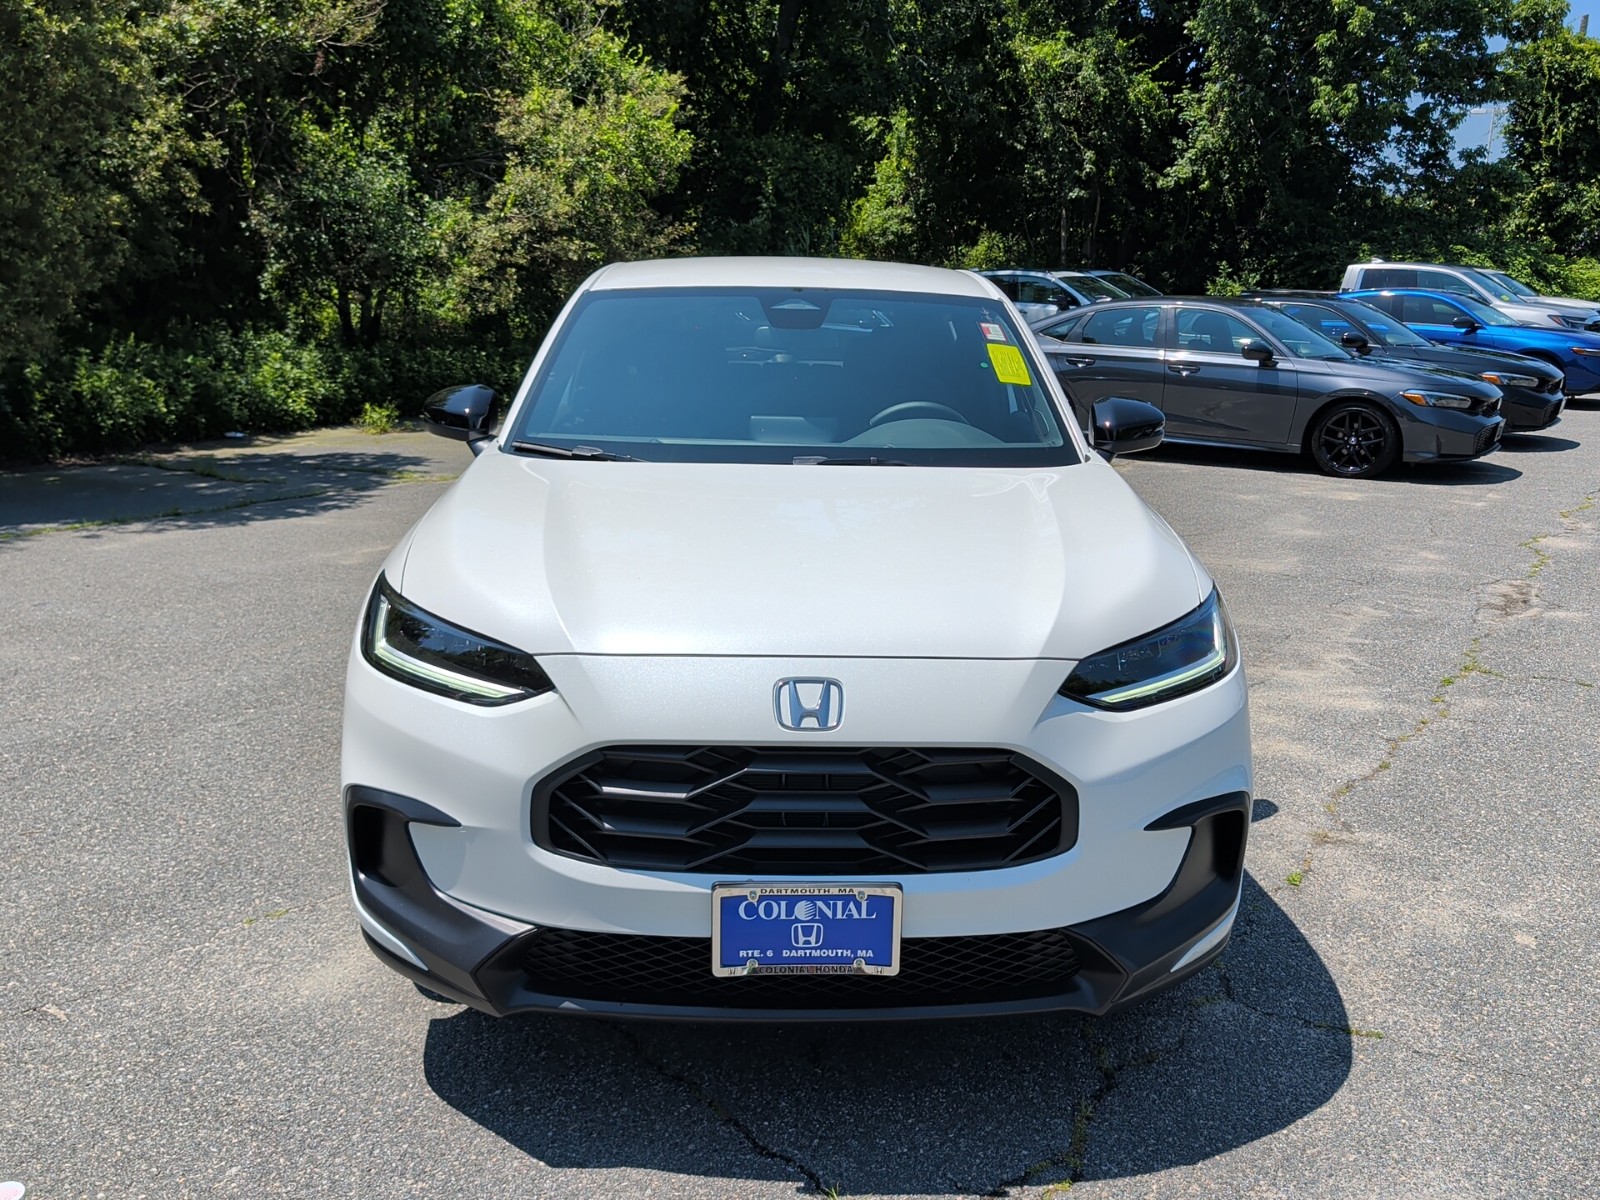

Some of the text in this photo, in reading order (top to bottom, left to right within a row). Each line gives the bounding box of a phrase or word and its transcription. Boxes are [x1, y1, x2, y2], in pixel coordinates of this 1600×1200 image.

[738, 900, 877, 920] COLONIAL
[739, 949, 874, 958] RTE. 6 DARTMOUTH, MA
[815, 965, 853, 974] HONDA
